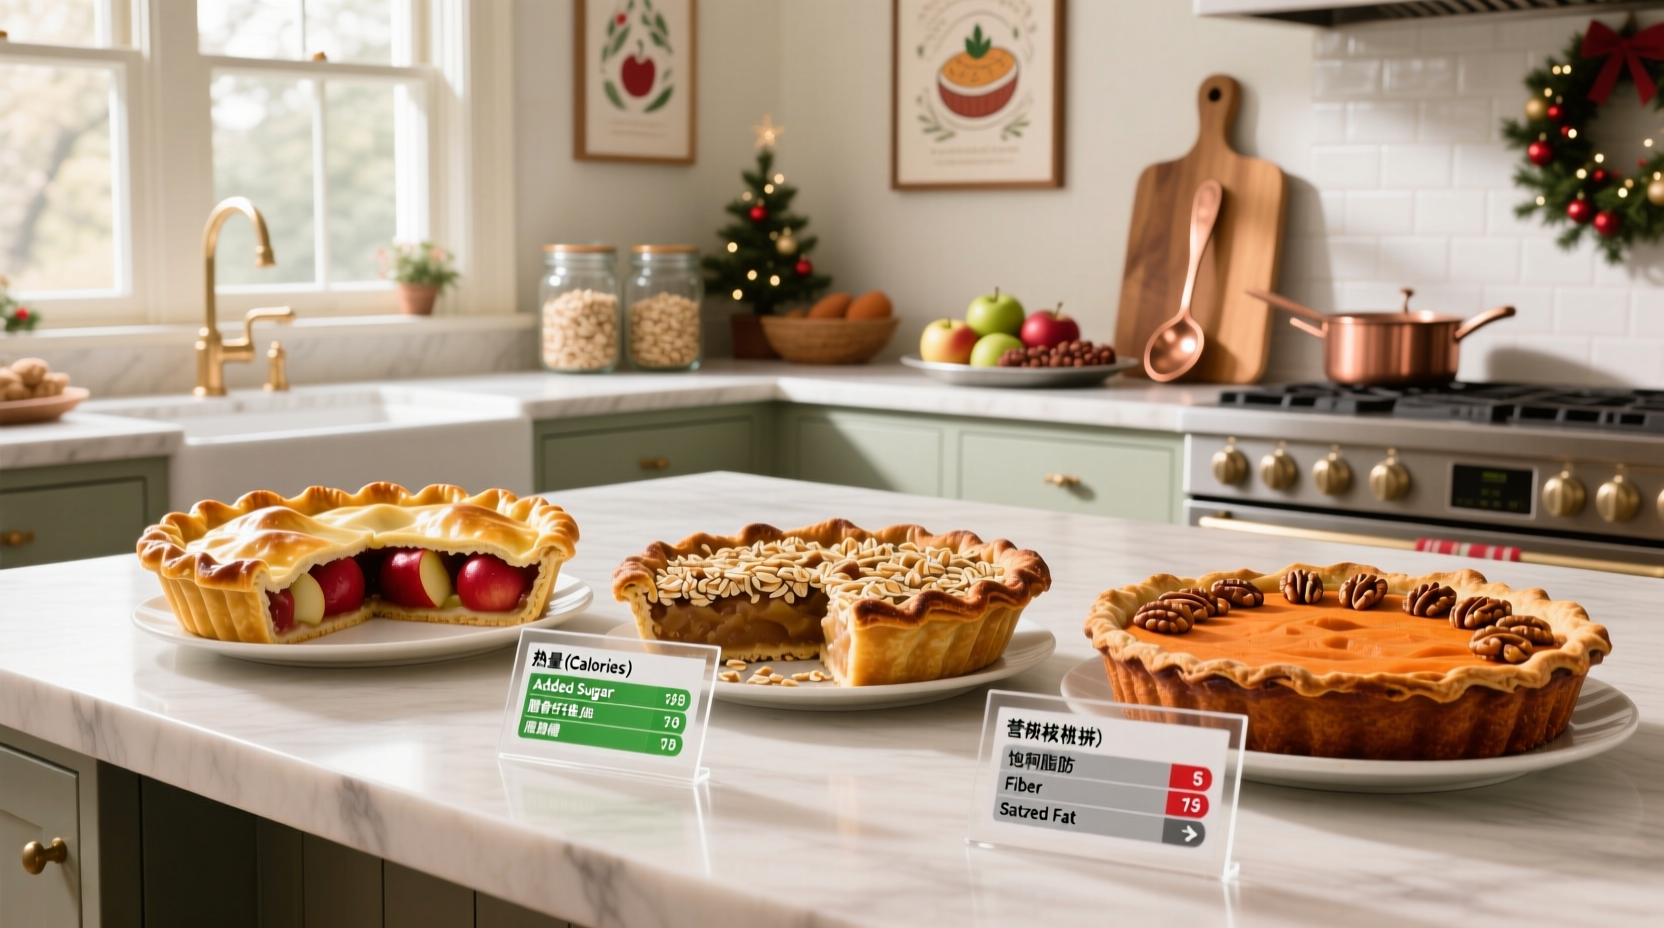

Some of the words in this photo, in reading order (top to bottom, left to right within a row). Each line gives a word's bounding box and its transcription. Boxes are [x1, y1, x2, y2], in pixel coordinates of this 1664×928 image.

[532, 678, 574, 694] Added
[577, 683, 615, 701] Sugar
[1005, 776, 1043, 794] Fiber
[1053, 808, 1077, 825] Fat
